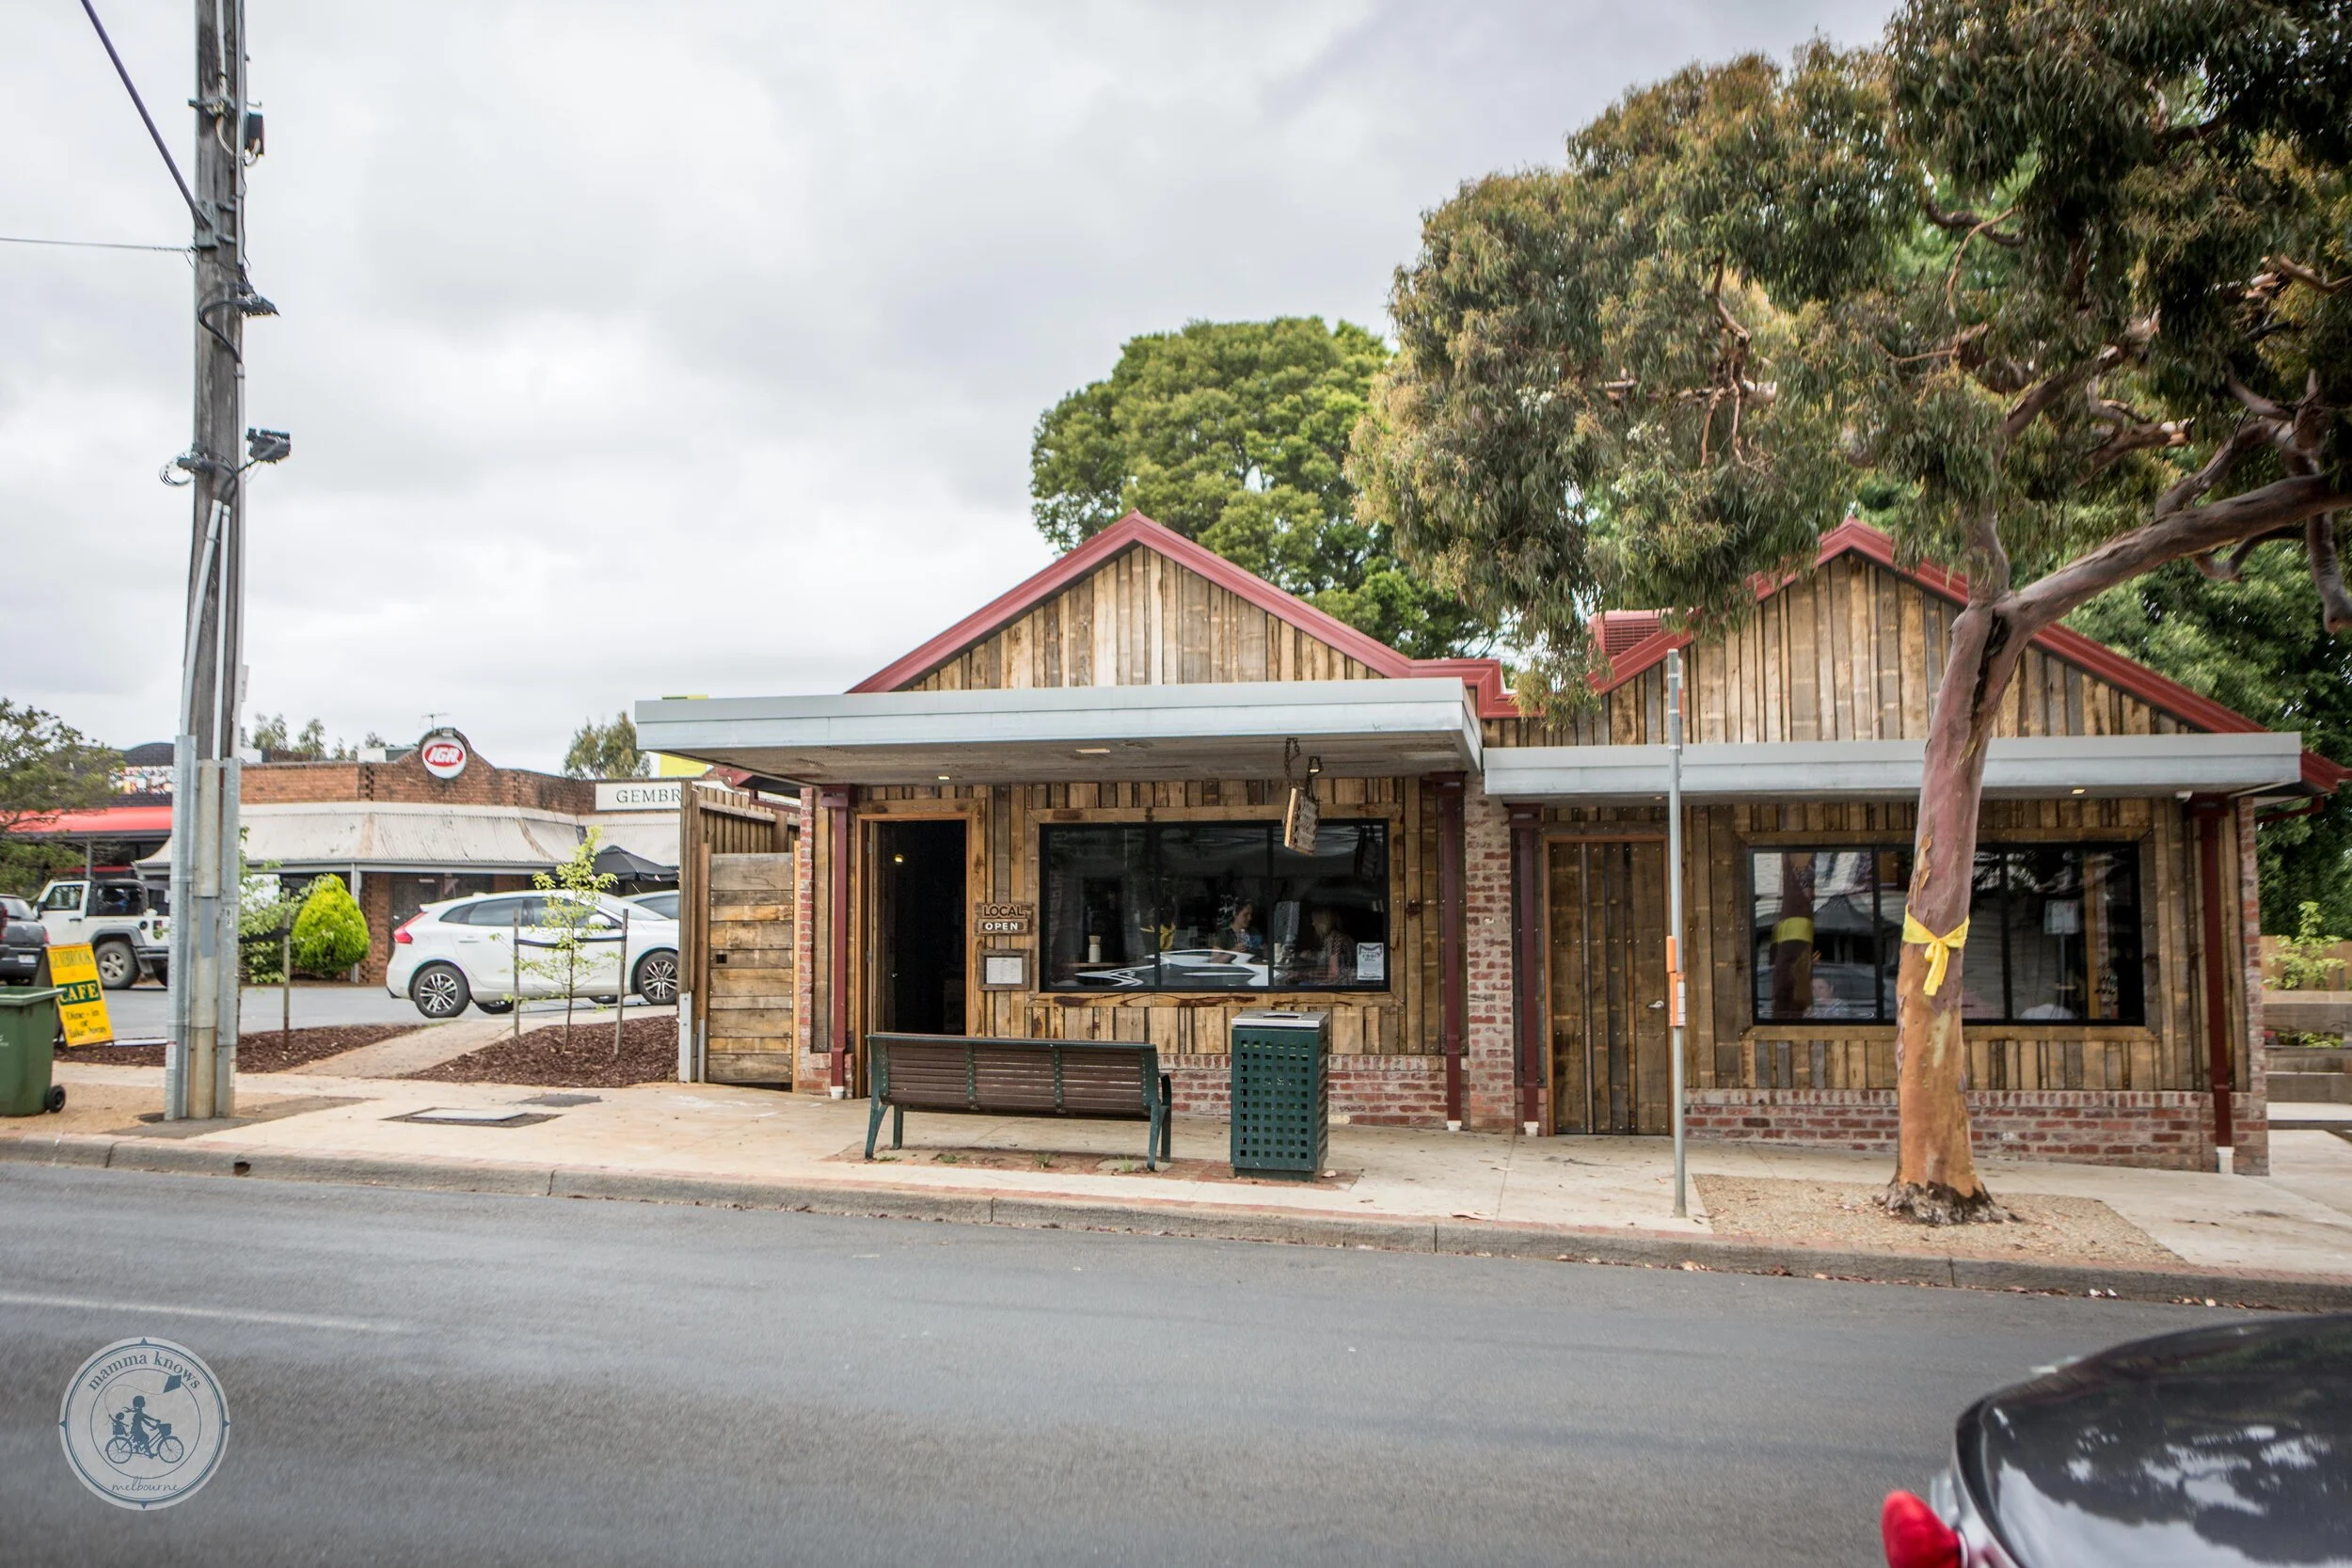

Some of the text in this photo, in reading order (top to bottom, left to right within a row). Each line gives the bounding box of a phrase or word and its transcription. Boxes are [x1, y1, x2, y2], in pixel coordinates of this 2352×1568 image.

[427, 746, 460, 764] IGA
[616, 789, 682, 803] GEMBR
[983, 906, 1025, 917] LOCAL
[985, 922, 1019, 931] OPEN
[58, 983, 99, 1004] CAFE
